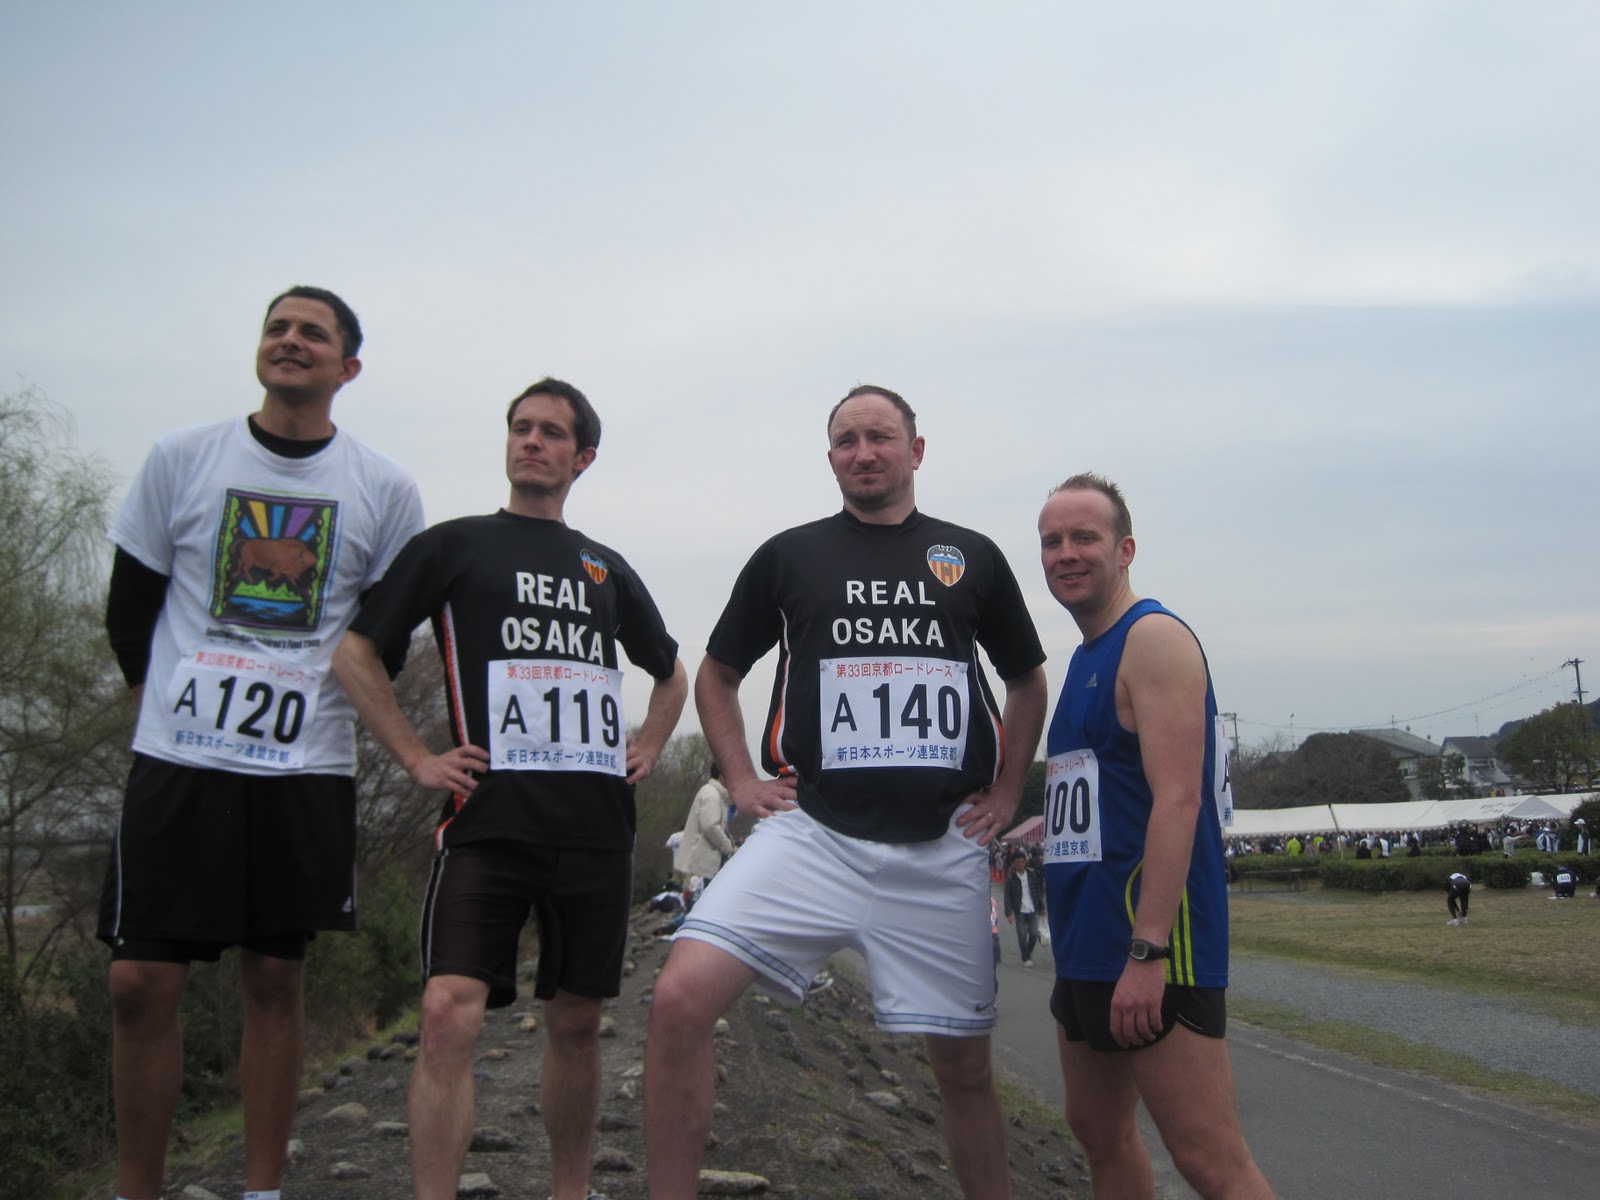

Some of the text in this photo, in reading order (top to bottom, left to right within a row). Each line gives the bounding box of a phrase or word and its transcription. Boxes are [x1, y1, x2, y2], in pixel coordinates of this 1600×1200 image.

[516, 571, 591, 615] REAL
[846, 580, 936, 606] REAL
[501, 616, 604, 666] OSAKA
[832, 617, 945, 648] OSAKA
[507, 665, 610, 686] 第33回京都ロードレース
[836, 661, 953, 679] 第33回京都ロードレース
[173, 675, 306, 744] A 120
[500, 686, 620, 748] A 119
[830, 682, 962, 740] A 140
[506, 749, 617, 770] 新日本スポーツ連盟京都
[837, 744, 958, 762] 新日本スポーツ連盟京都
[1043, 840, 1090, 857] ーツ連盟京都
